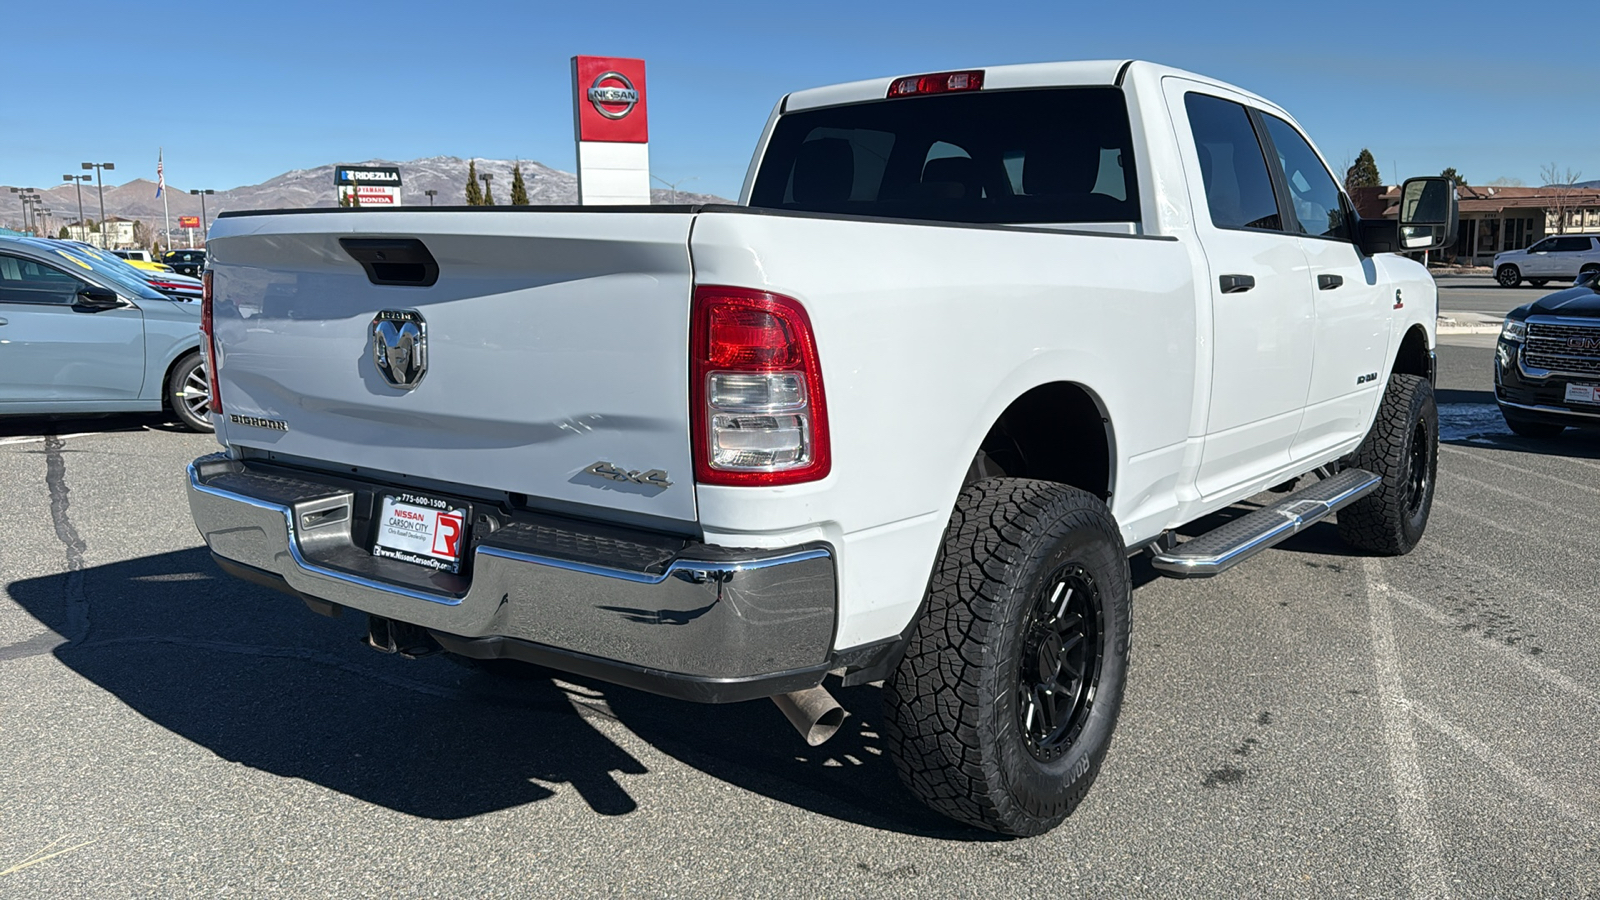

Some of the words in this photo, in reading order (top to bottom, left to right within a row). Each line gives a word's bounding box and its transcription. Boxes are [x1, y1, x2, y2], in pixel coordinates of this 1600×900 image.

[594, 90, 635, 100] NISSAN
[355, 171, 398, 181] RIDEZILLA
[381, 311, 413, 320] RAM
[1356, 372, 1378, 385] RAM
[230, 413, 289, 432] BIGHORN
[402, 493, 447, 509] 775-600-1500
[394, 509, 425, 521] NISSAN
[389, 517, 414, 529] CARSON
[415, 523, 429, 532] CITY
[408, 532, 427, 542] Dealership
